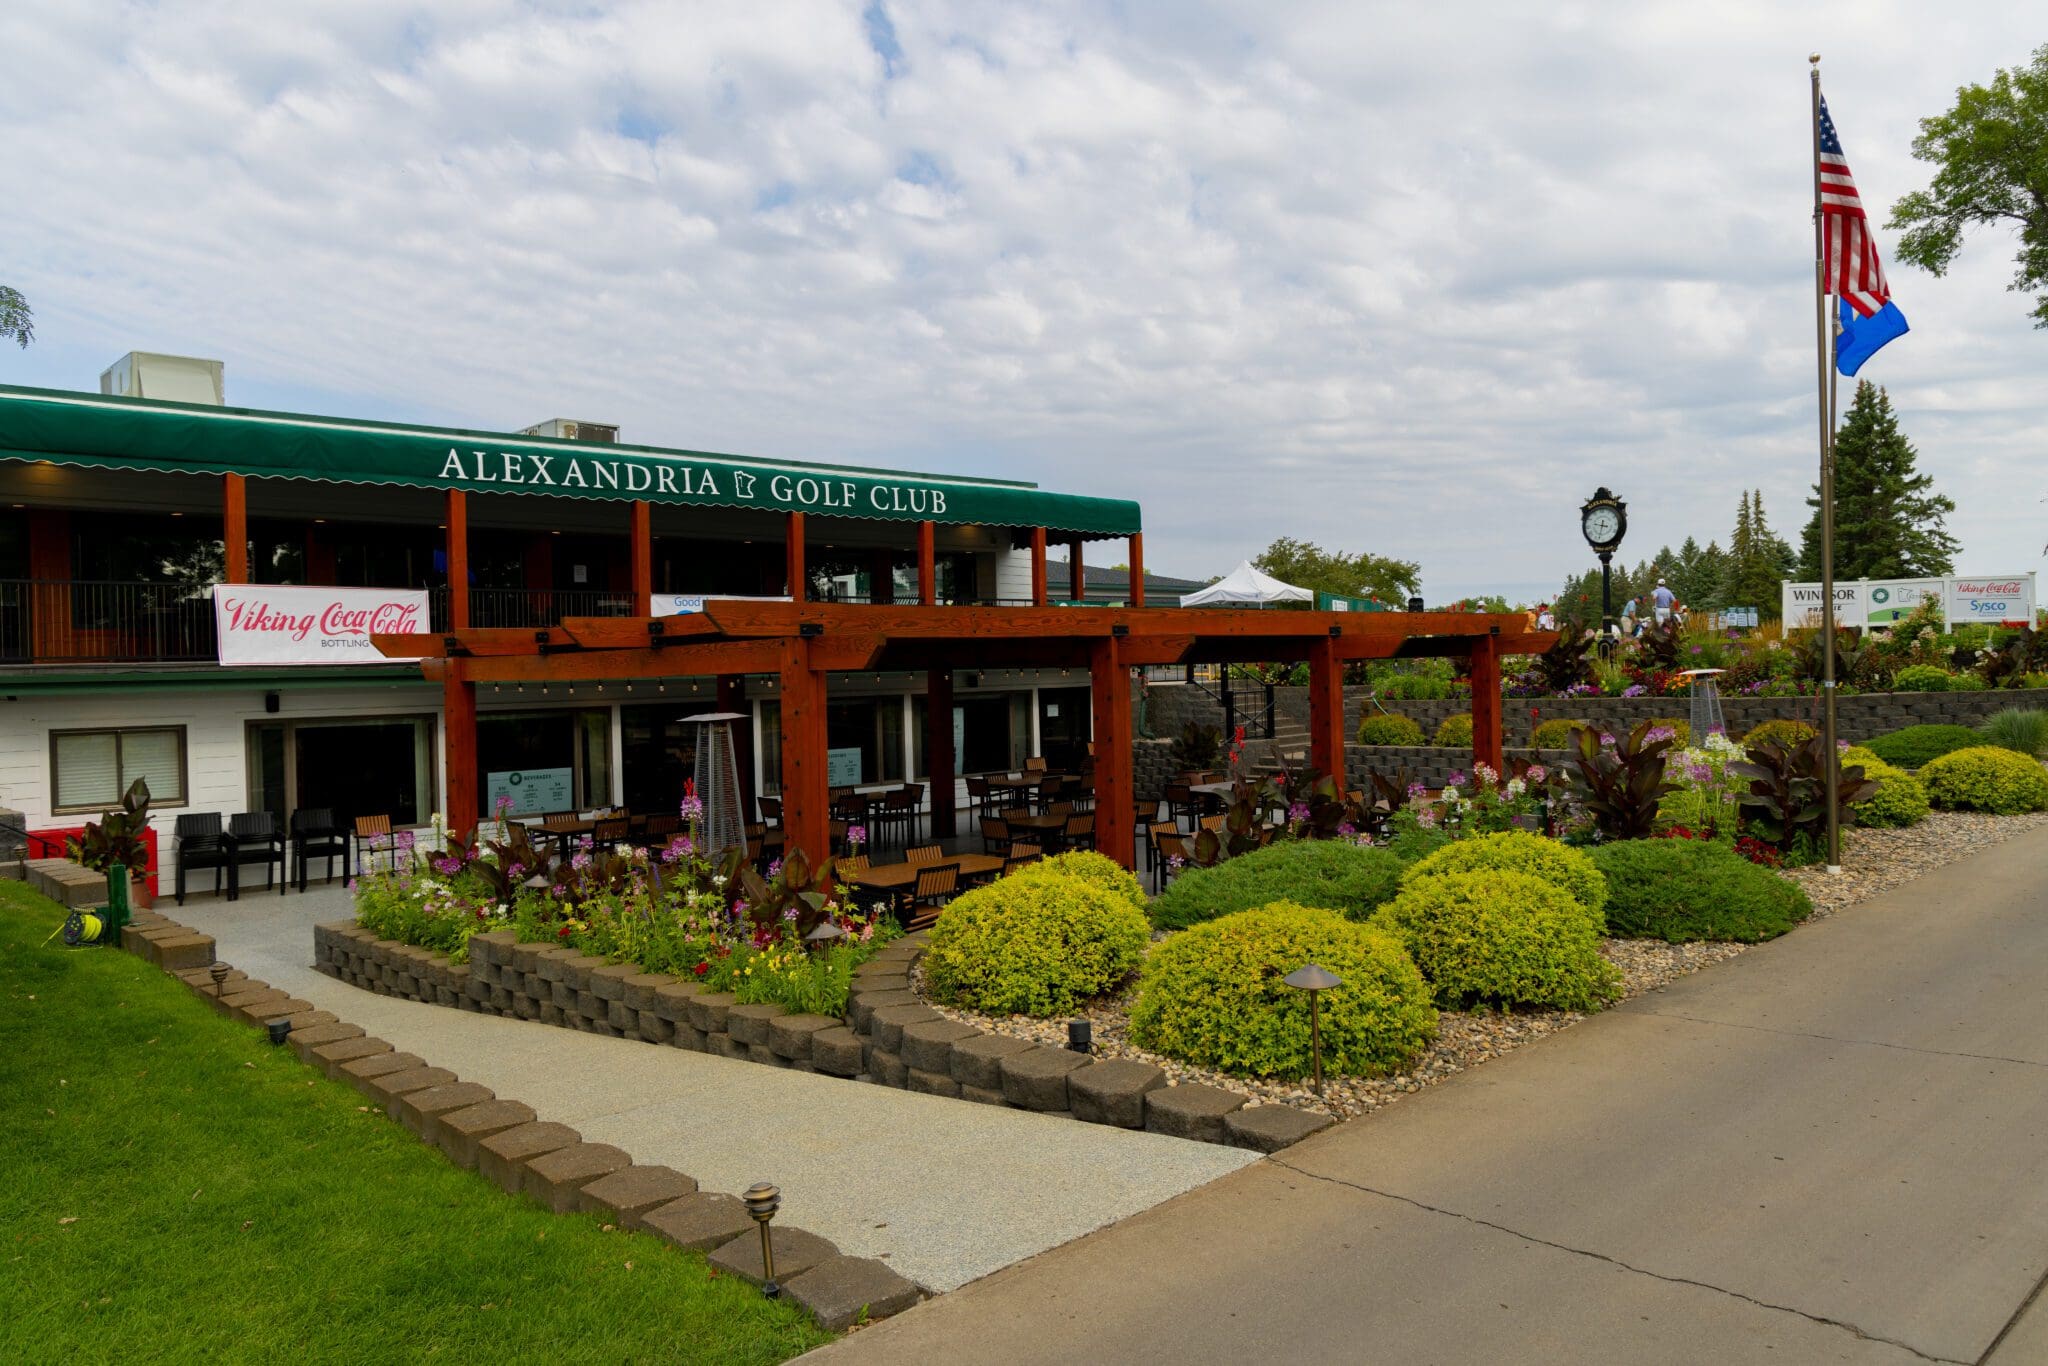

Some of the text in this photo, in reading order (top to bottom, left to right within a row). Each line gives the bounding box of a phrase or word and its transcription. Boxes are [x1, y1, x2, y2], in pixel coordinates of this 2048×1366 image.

[438, 448, 947, 514] ALEXANDRIA GOLF CLUB
[1793, 589, 1855, 601] WINSOR
[674, 597, 701, 607] Good
[1970, 599, 2006, 612] Sysco
[225, 598, 317, 642] Viking
[321, 639, 369, 648] BOTTLING
